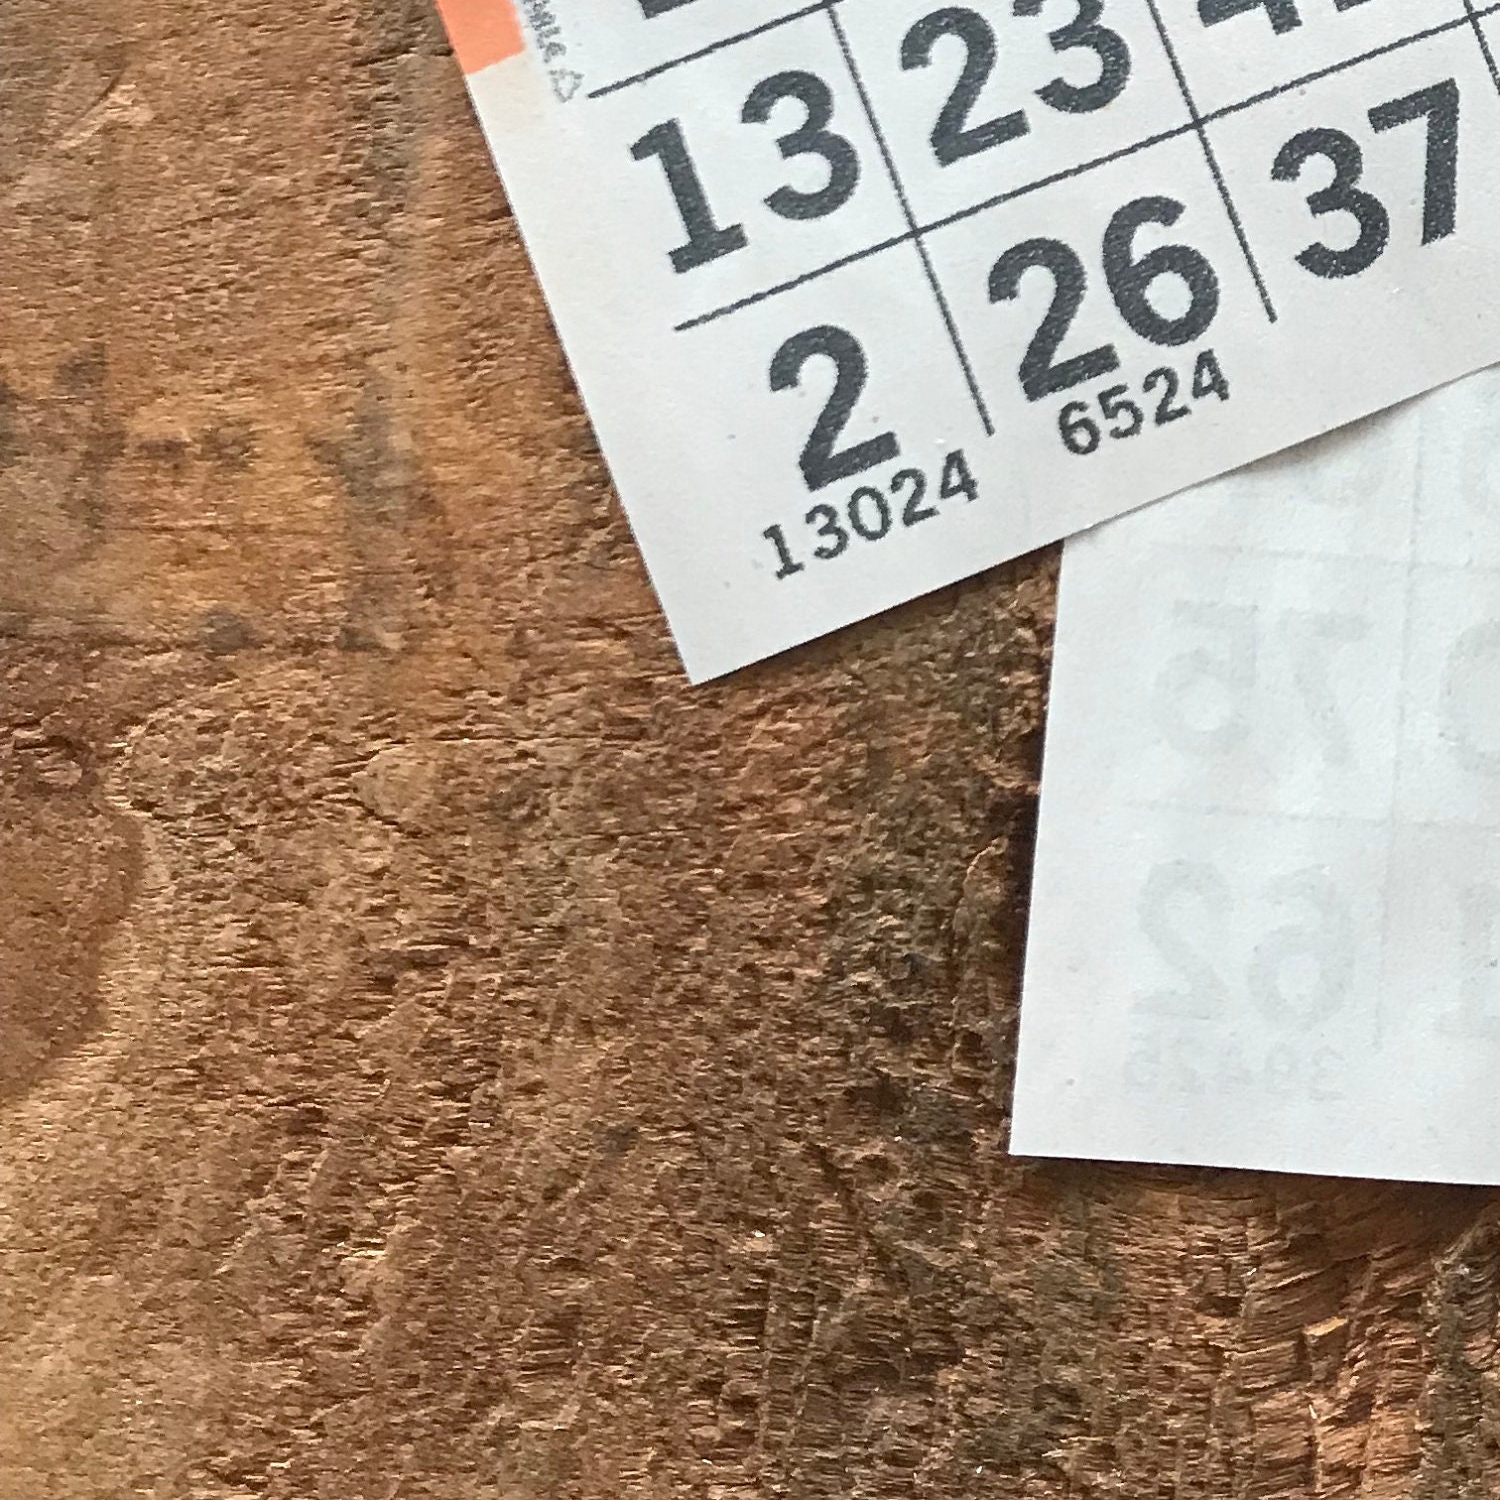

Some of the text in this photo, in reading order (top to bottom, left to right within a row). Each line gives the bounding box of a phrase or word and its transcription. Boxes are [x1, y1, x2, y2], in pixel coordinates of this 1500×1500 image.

[629, 70, 861, 275] 13
[768, 324, 901, 493] 2
[987, 195, 1220, 403] 26
[1270, 77, 1460, 280] 37
[762, 448, 979, 581] 13024
[1057, 348, 1230, 456] 6524
